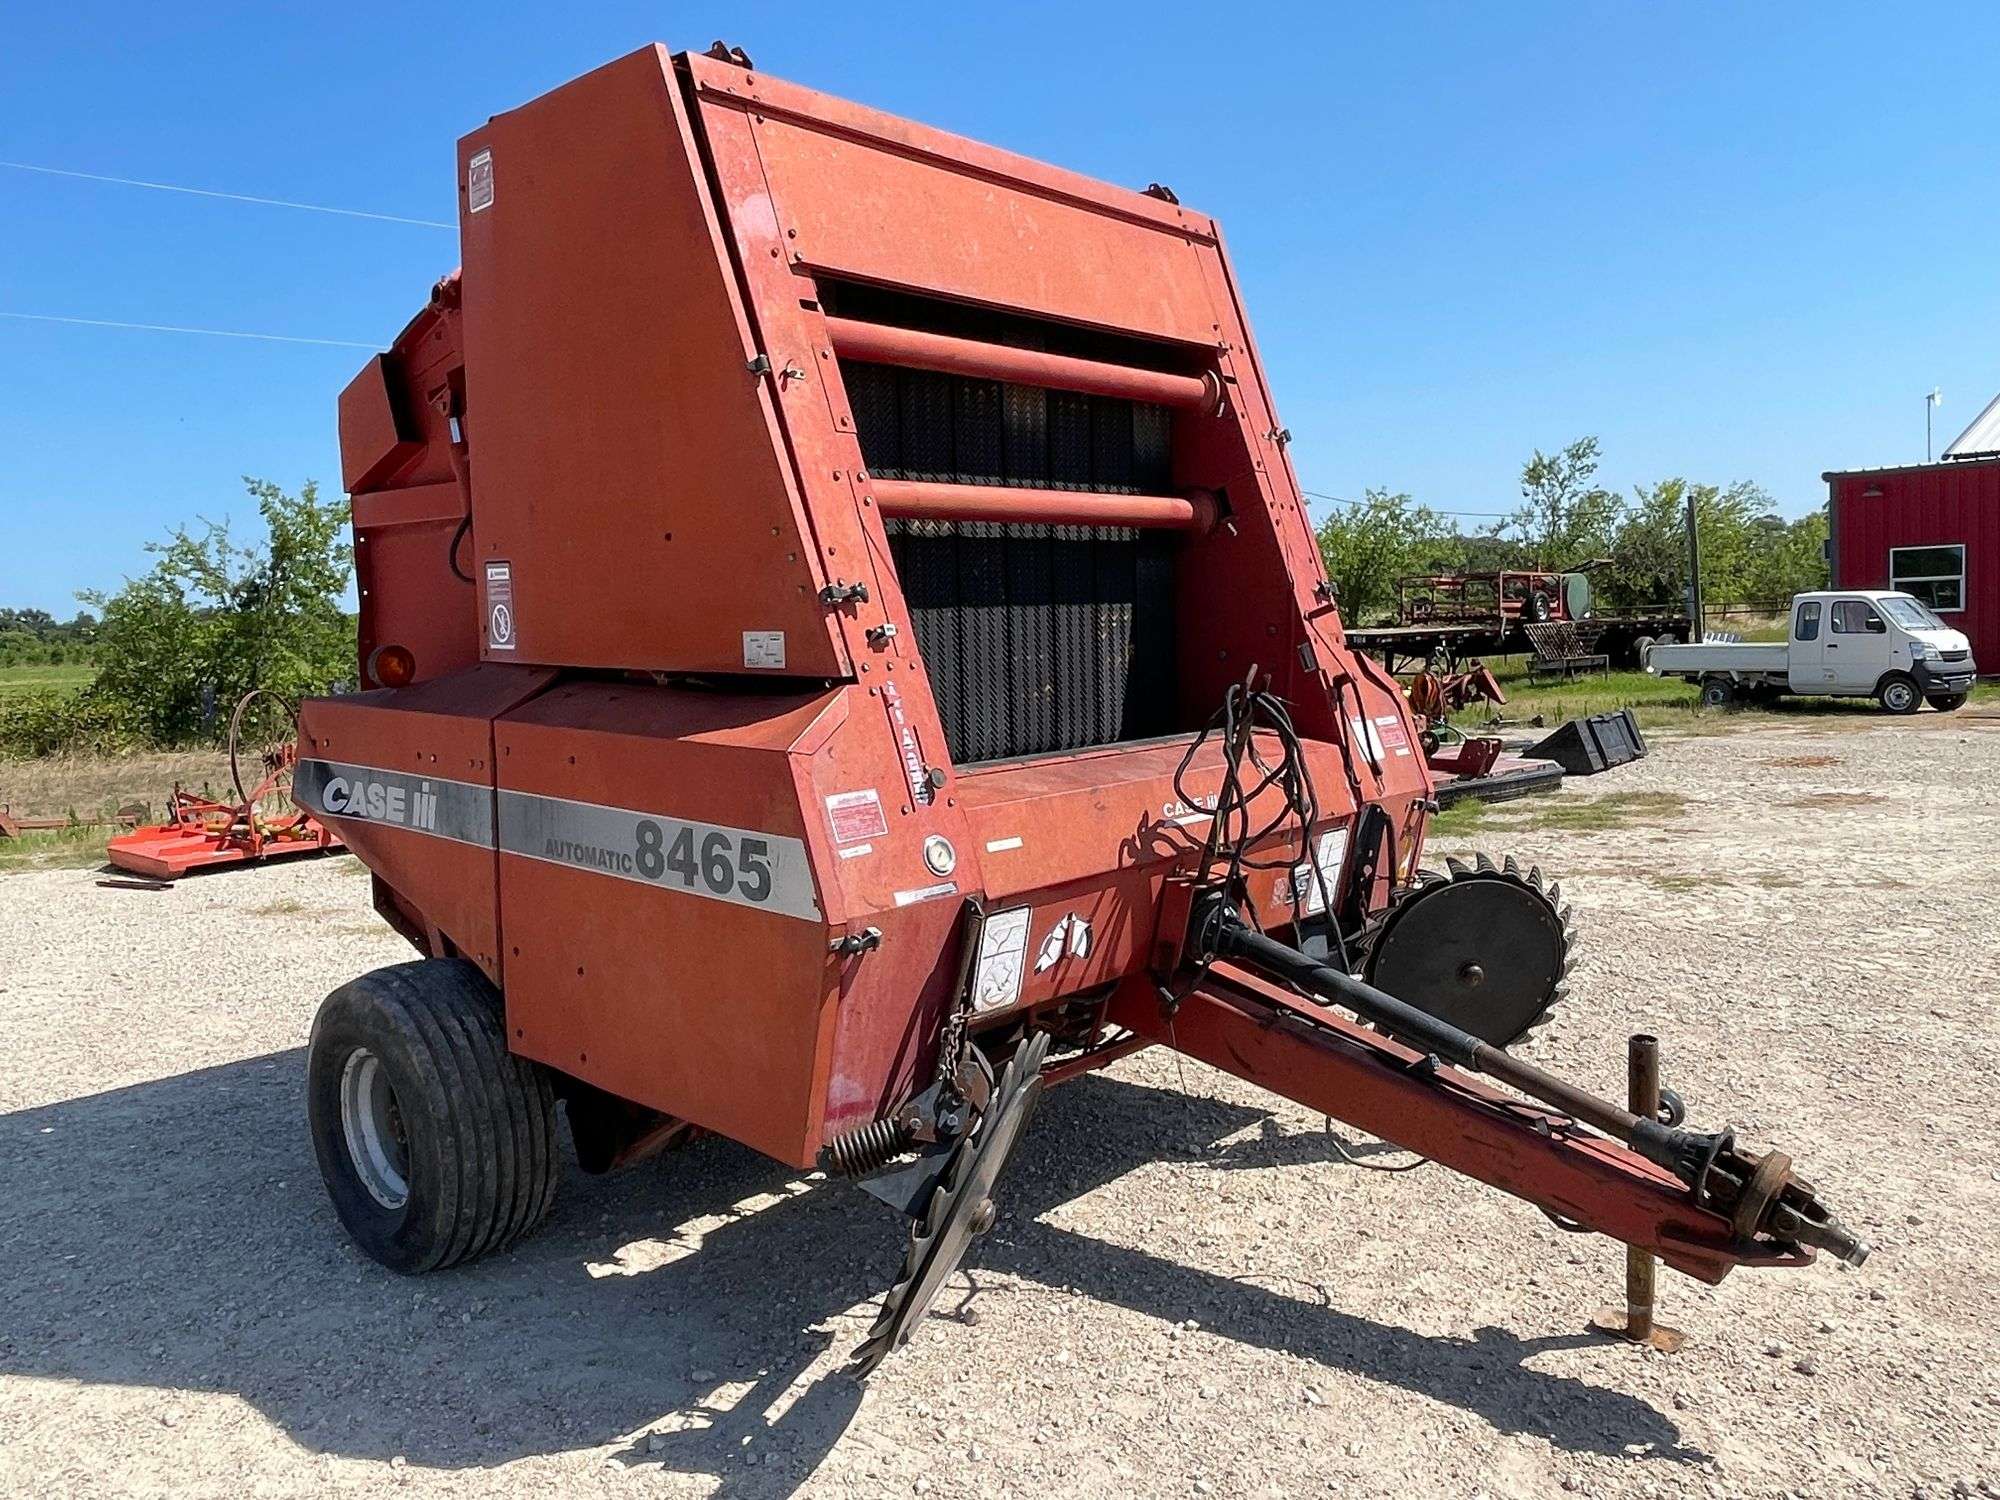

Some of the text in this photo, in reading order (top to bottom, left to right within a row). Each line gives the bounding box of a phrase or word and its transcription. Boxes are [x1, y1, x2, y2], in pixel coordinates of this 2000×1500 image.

[322, 777, 406, 823] CASE
[545, 838, 632, 873] AUTOMATIC
[635, 819, 772, 902] 8465
